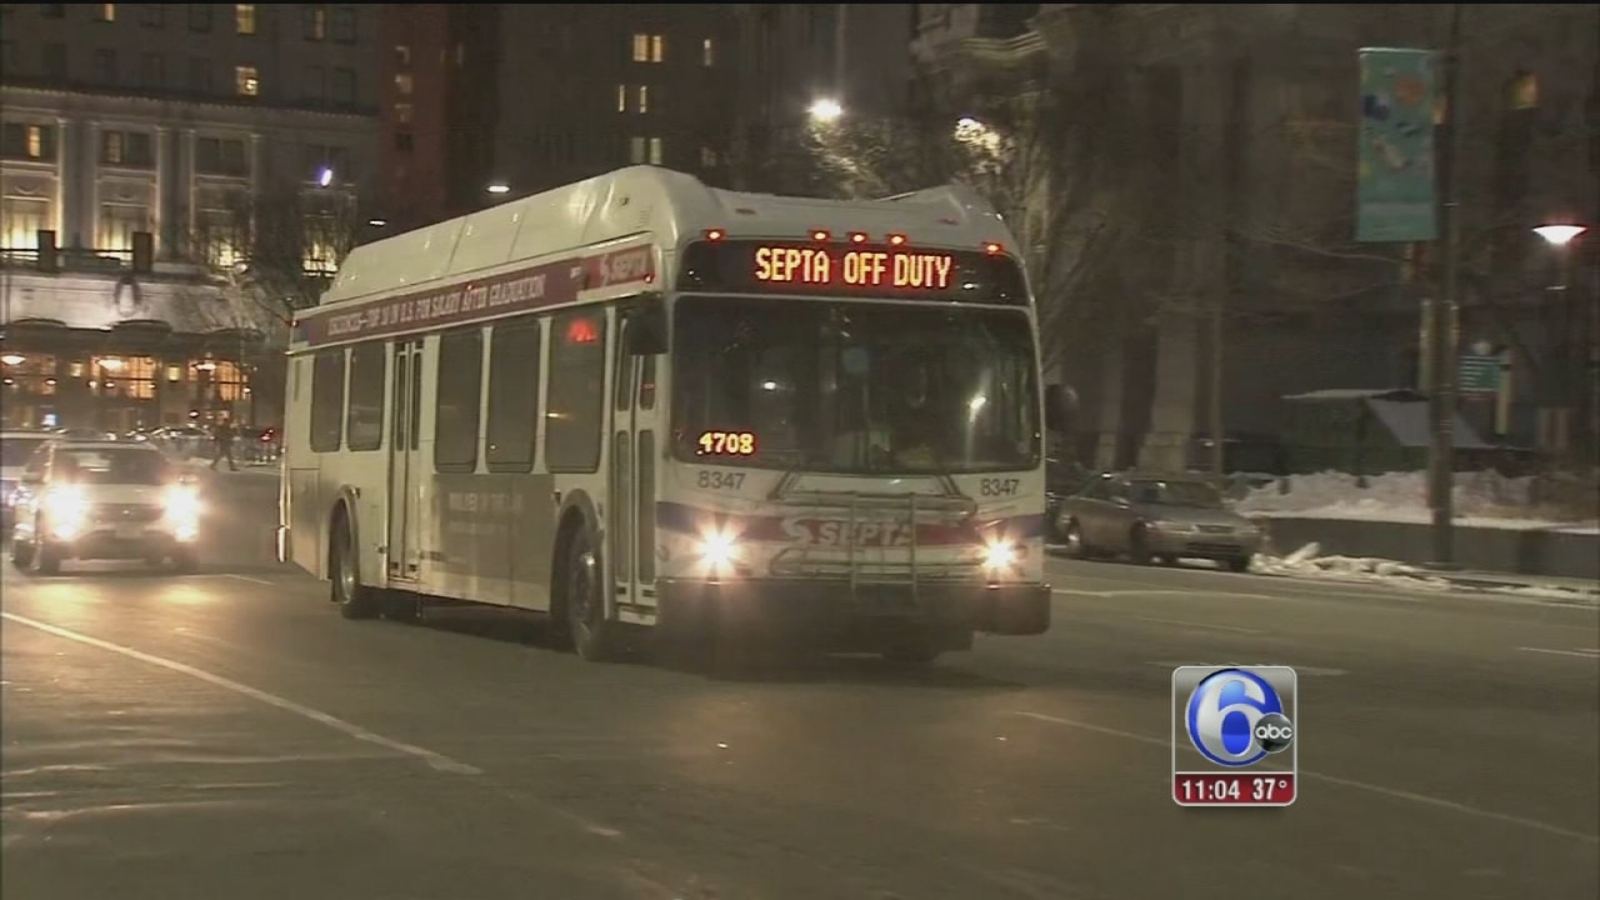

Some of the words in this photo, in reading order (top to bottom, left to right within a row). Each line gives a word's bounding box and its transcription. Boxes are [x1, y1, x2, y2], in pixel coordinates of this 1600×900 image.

[755, 247, 830, 284] SEPTA
[843, 251, 888, 285] OFF
[893, 254, 952, 288] DUTY
[698, 431, 755, 455] 4708
[697, 470, 747, 492] 8347
[980, 477, 1021, 496] 8347
